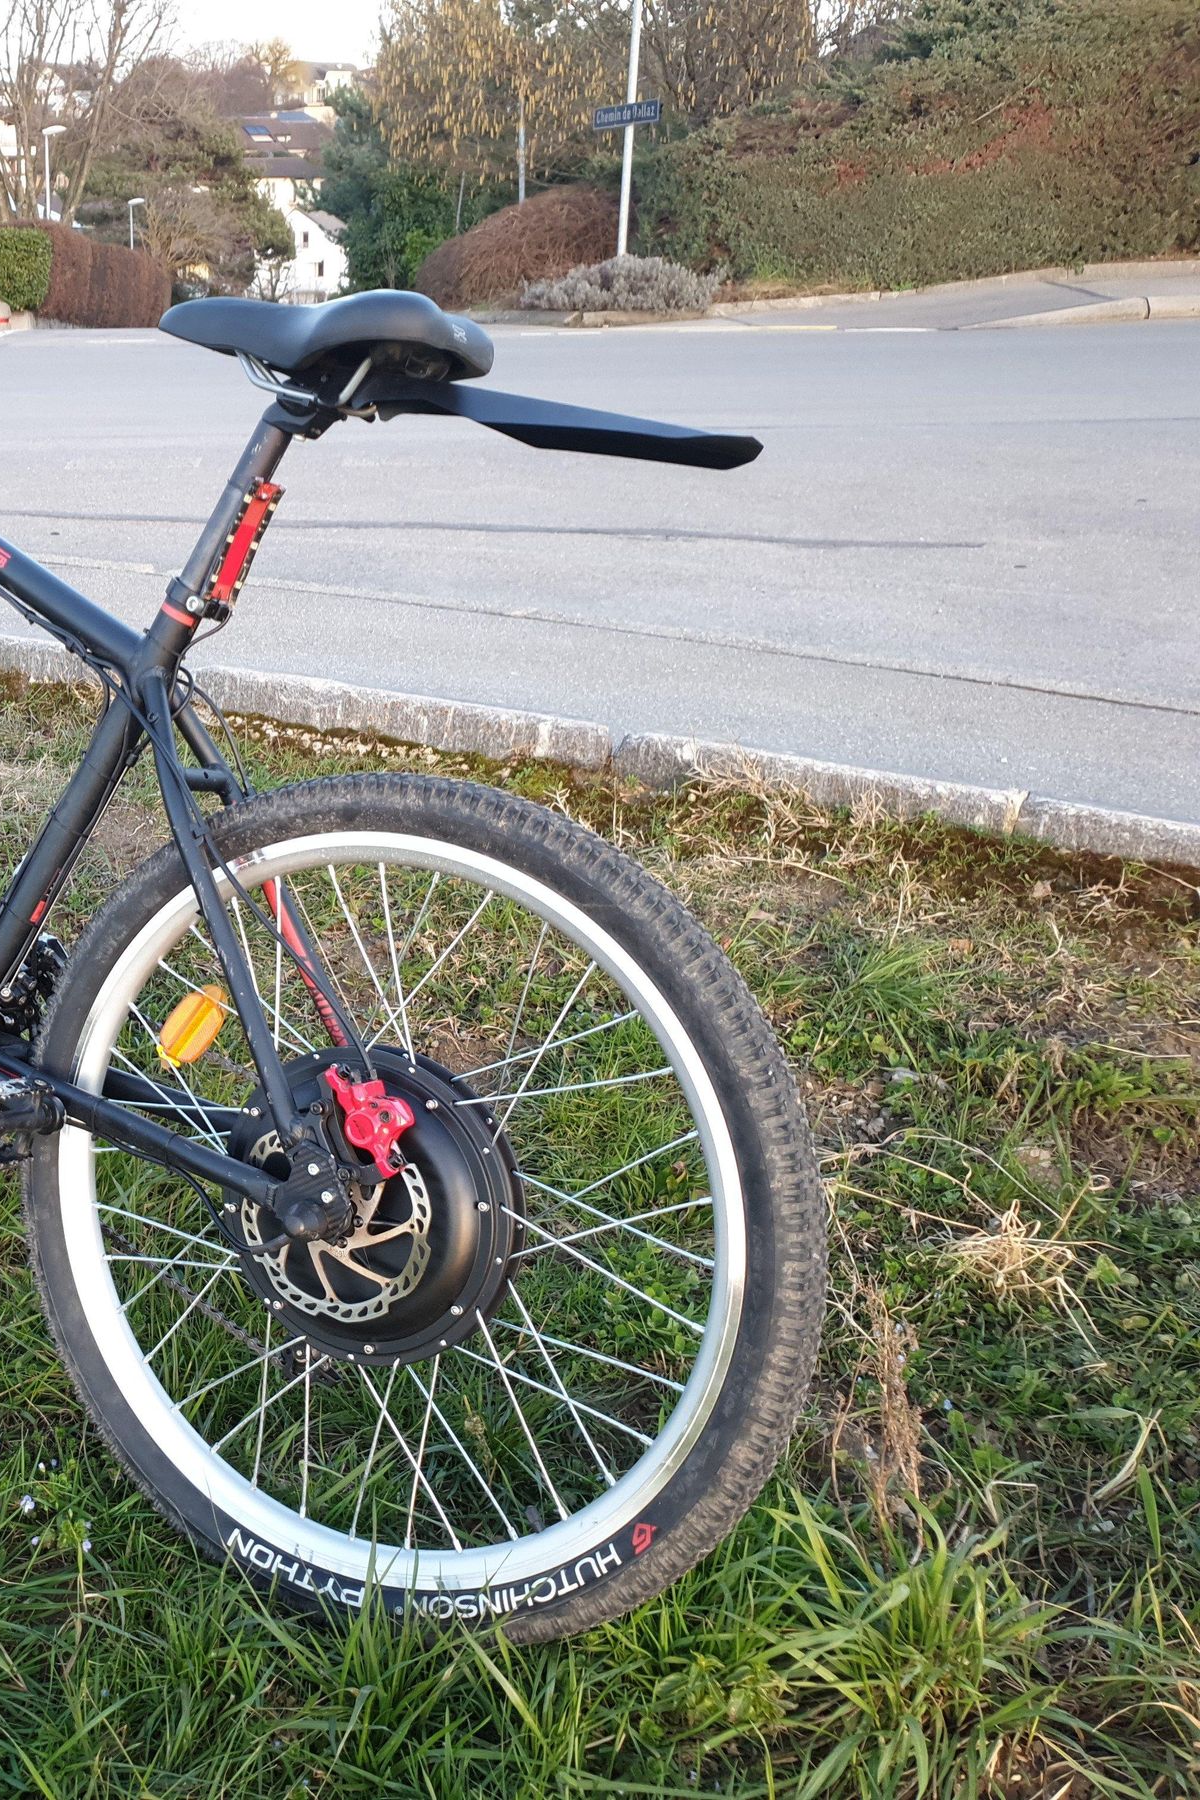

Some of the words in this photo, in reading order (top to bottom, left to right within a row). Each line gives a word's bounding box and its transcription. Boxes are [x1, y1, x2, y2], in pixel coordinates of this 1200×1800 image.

[596, 107, 621, 124] Chemin
[622, 106, 631, 120] de
[226, 1527, 365, 1608] PYTHON
